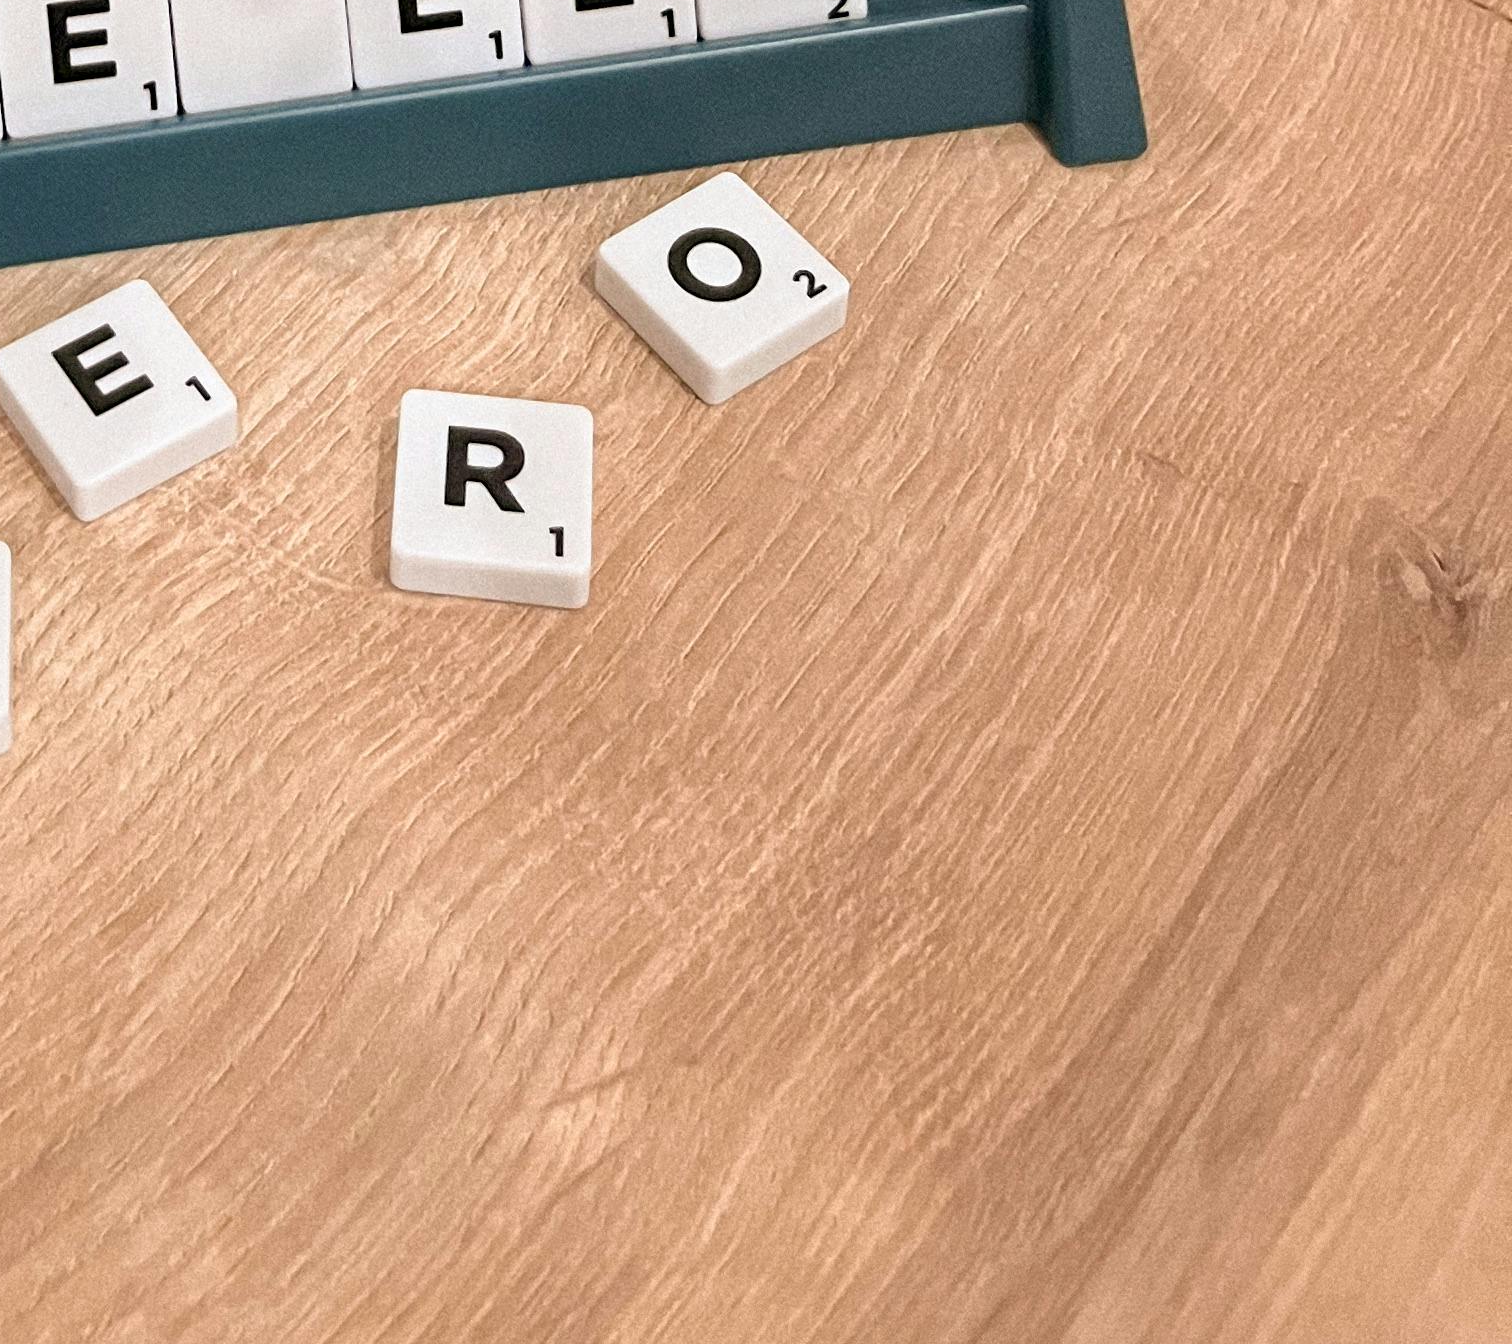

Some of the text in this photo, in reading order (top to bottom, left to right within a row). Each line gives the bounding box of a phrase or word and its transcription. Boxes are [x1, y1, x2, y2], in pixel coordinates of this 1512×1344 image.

[666, 226, 763, 304] O
[791, 268, 829, 300] 2
[50, 323, 155, 418] E
[183, 375, 212, 403] 1
[442, 424, 526, 515] R
[547, 525, 565, 558] 1
